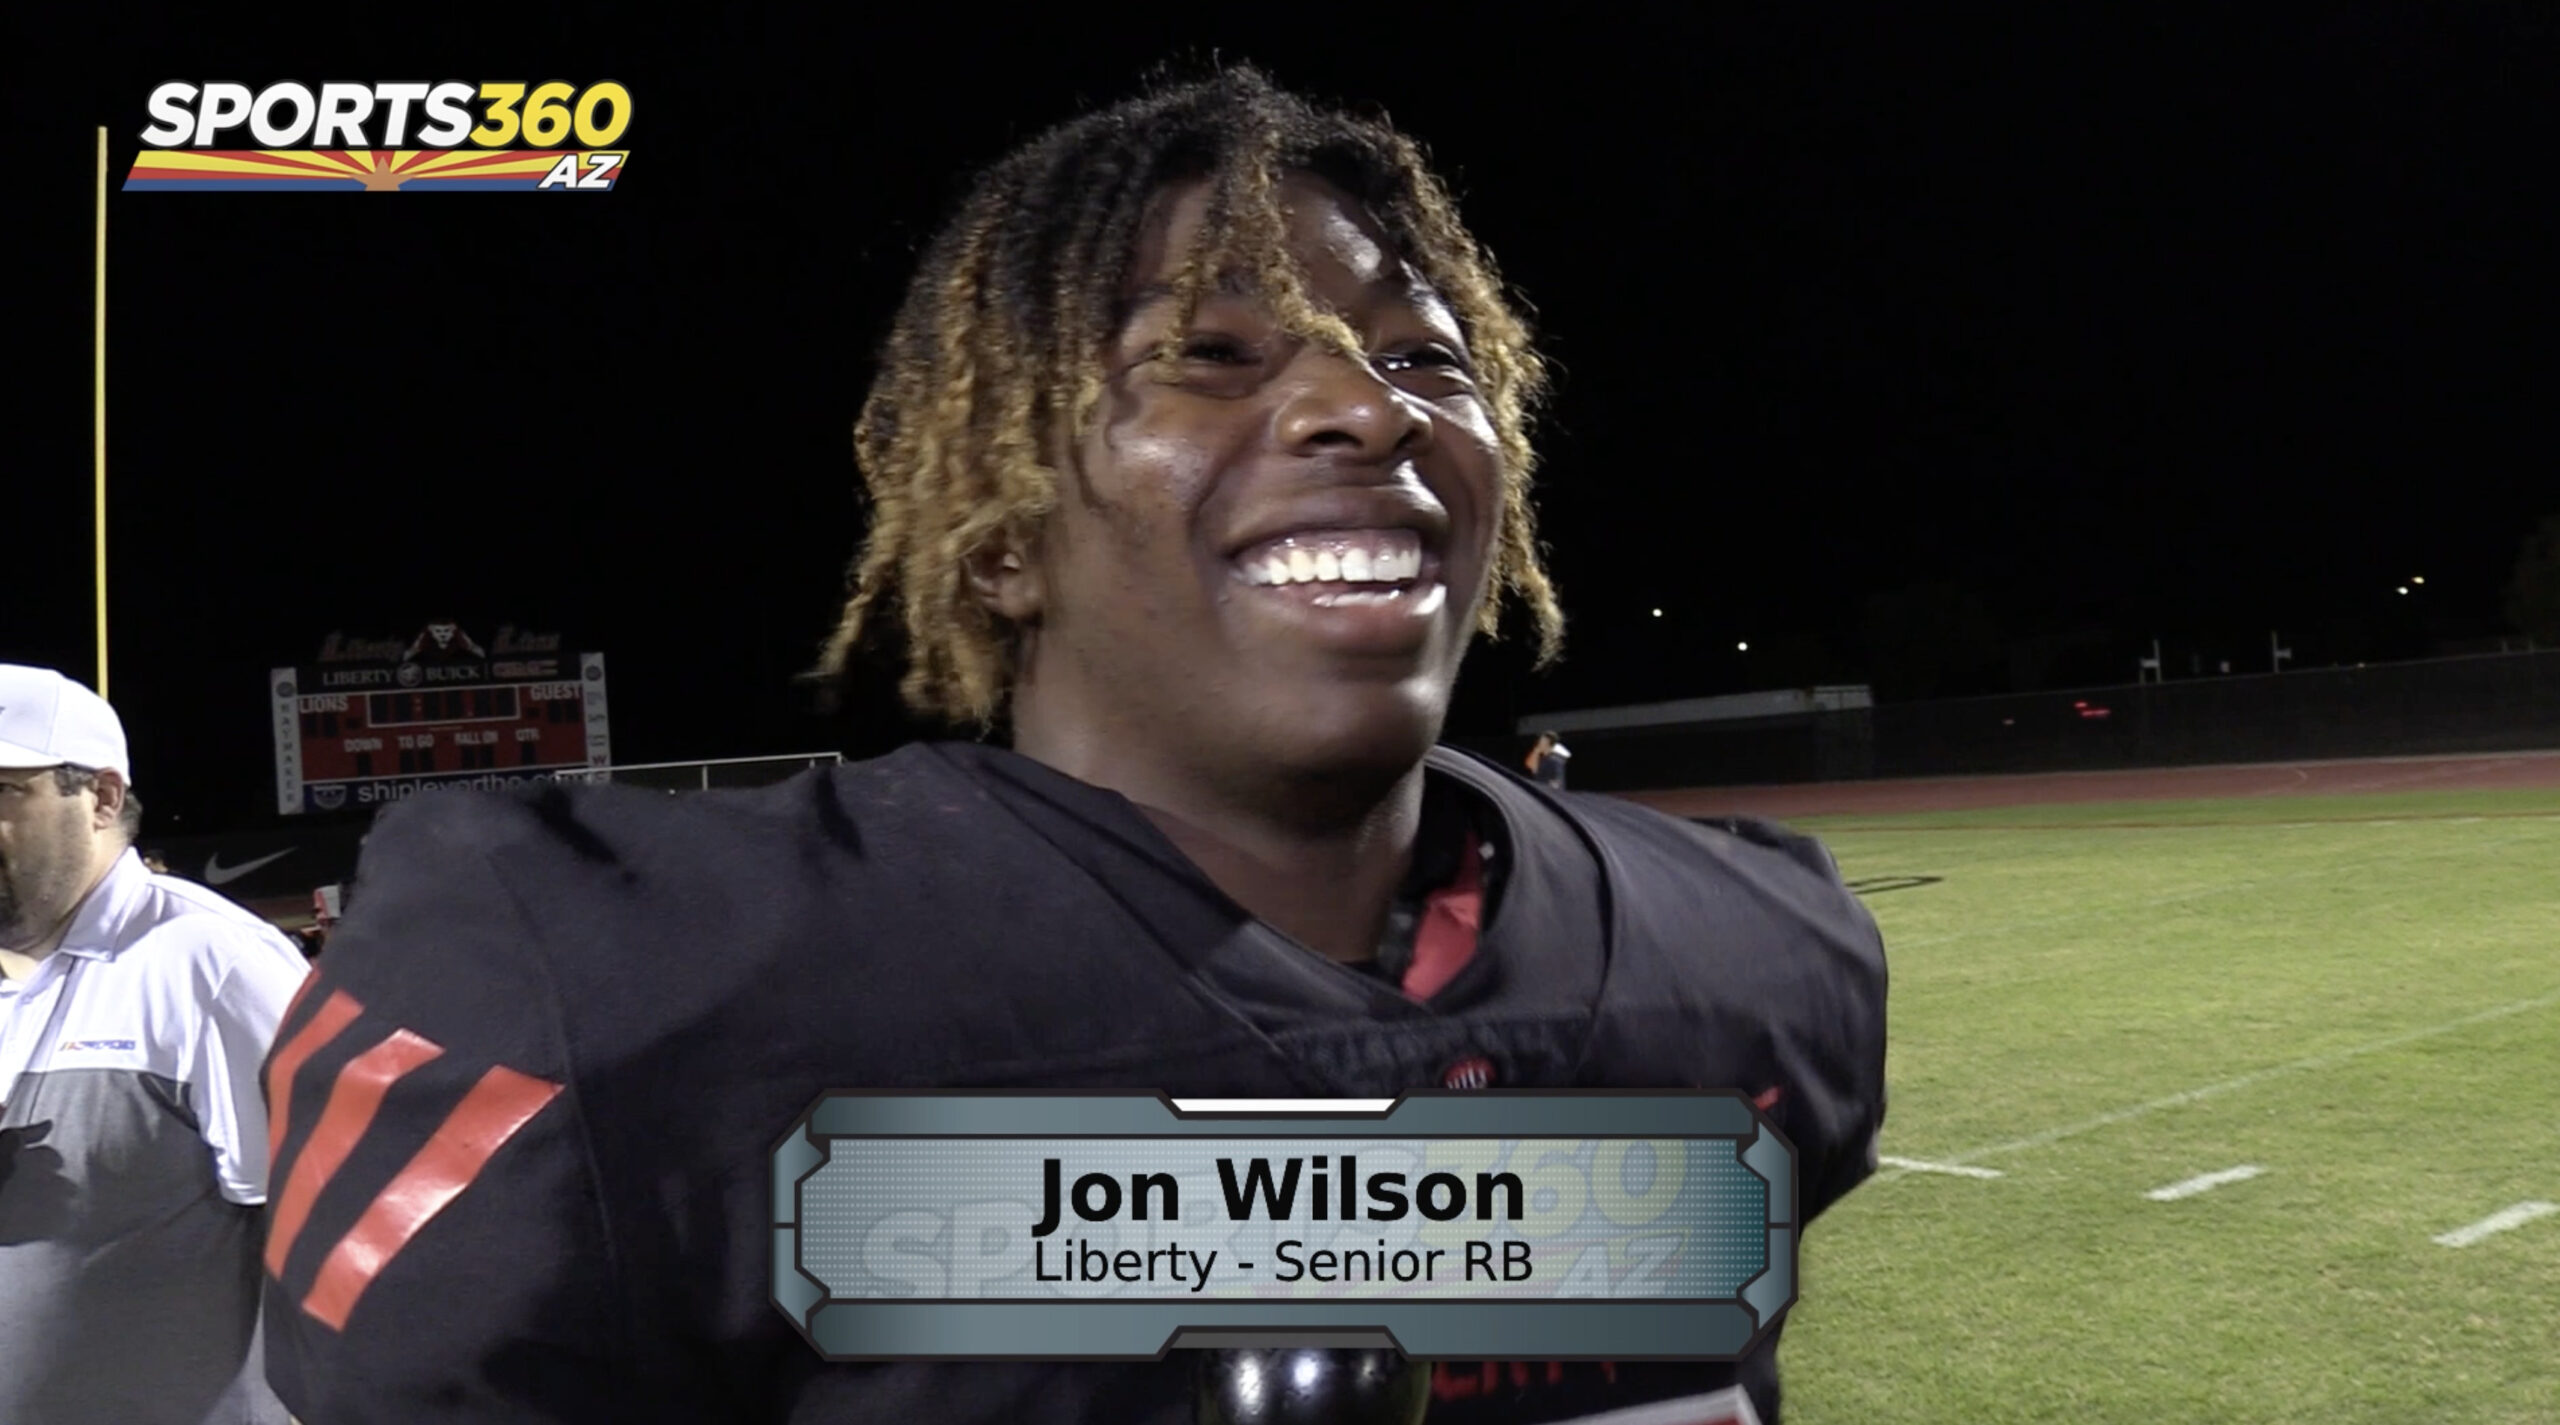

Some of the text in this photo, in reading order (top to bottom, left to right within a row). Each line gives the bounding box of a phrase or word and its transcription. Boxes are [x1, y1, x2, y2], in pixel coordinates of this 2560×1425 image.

[322, 668, 393, 687] LIBERTY
[424, 664, 481, 681] BUICK
[529, 684, 583, 701] GUEST
[300, 695, 349, 714] LIONS
[397, 733, 435, 750] TO GO
[515, 727, 540, 742] QTR
[343, 737, 383, 753] DOWN
